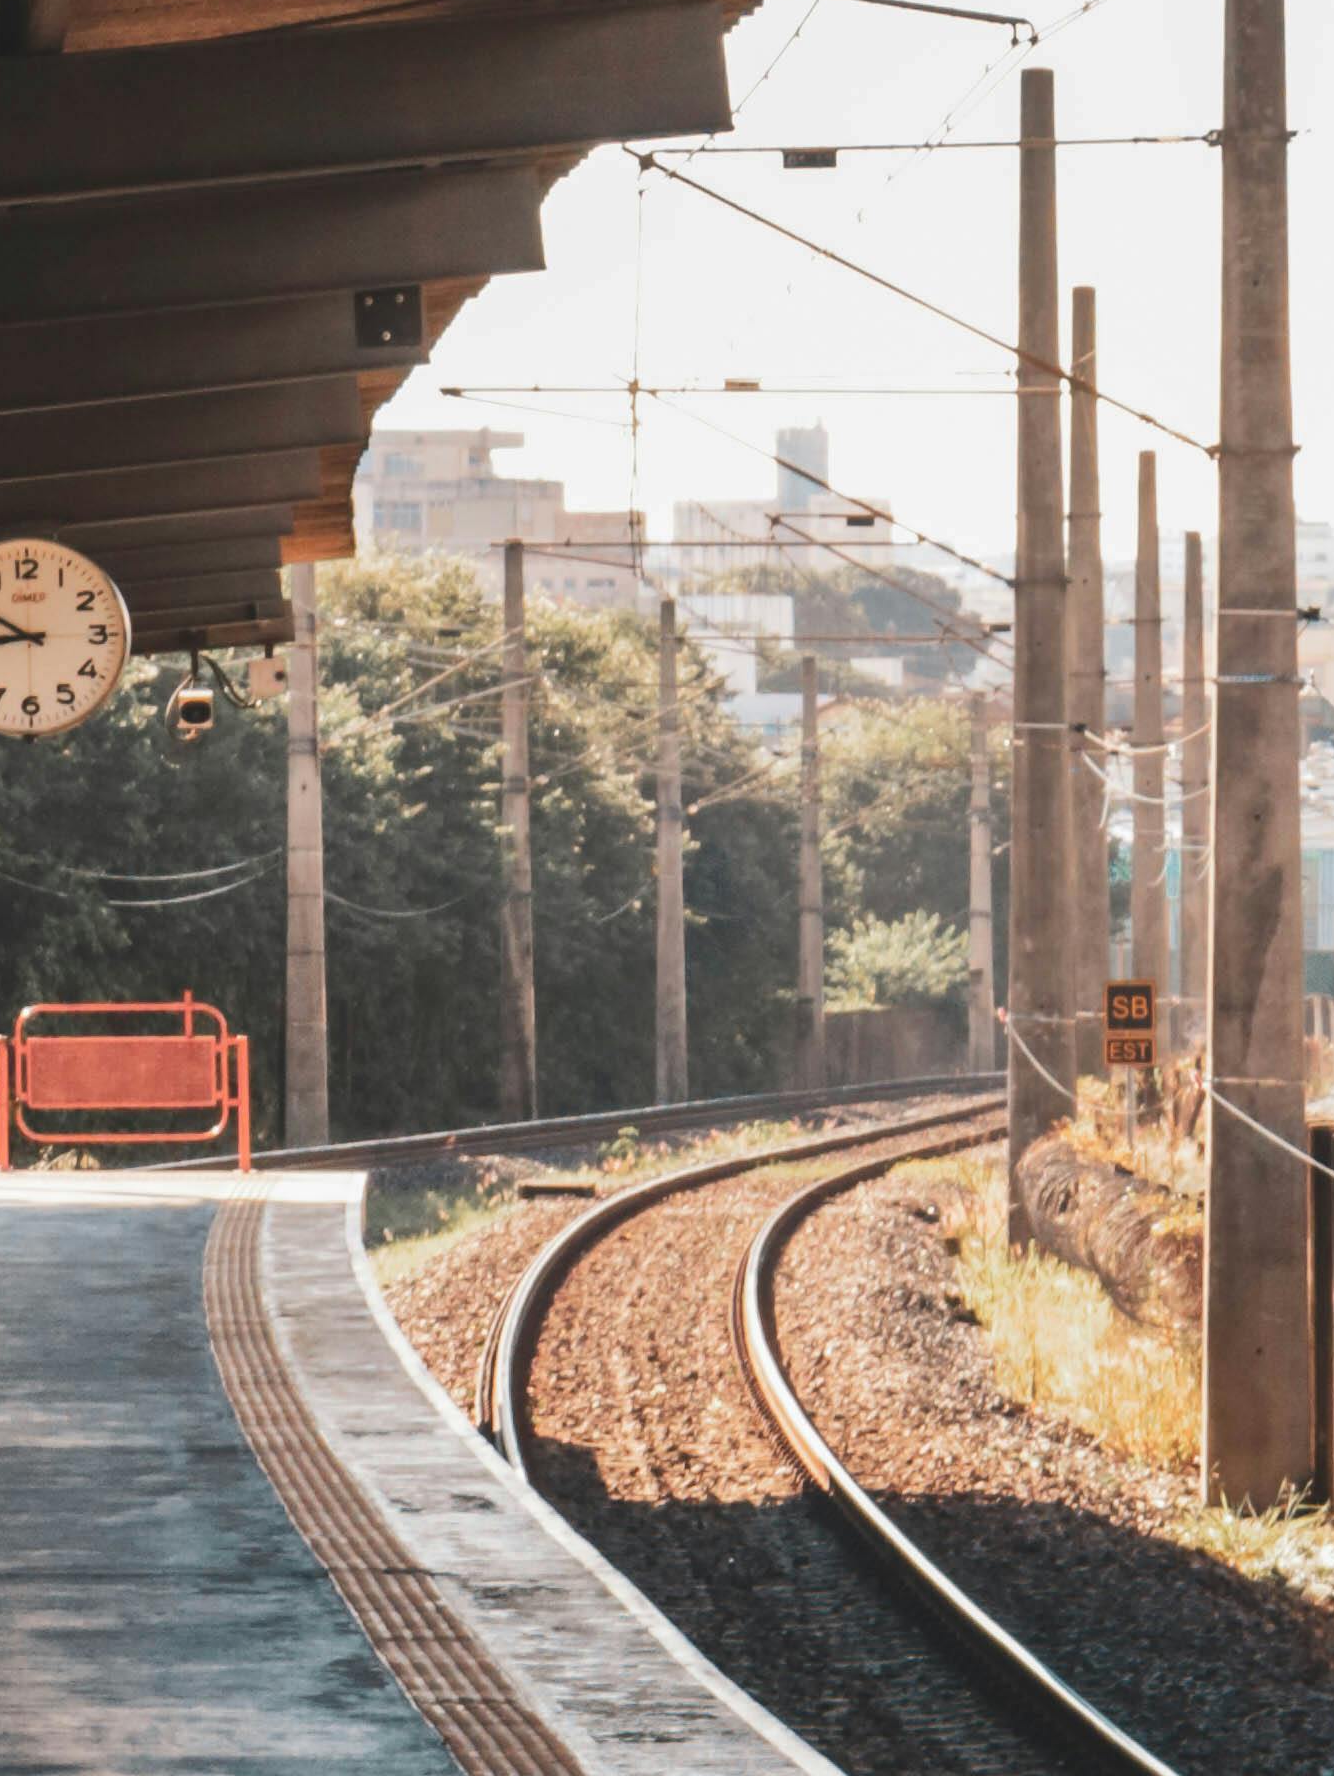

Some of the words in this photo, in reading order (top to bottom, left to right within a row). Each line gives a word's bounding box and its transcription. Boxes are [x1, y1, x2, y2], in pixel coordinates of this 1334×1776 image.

[14, 559, 39, 580] 12
[58, 568, 64, 588] 1
[76, 591, 96, 611] 2
[88, 625, 108, 645] 3
[77, 658, 97, 679] 4
[56, 684, 76, 705] 5
[21, 696, 41, 716] 6
[1112, 995, 1149, 1020] SB
[1109, 1041, 1149, 1060] EST
